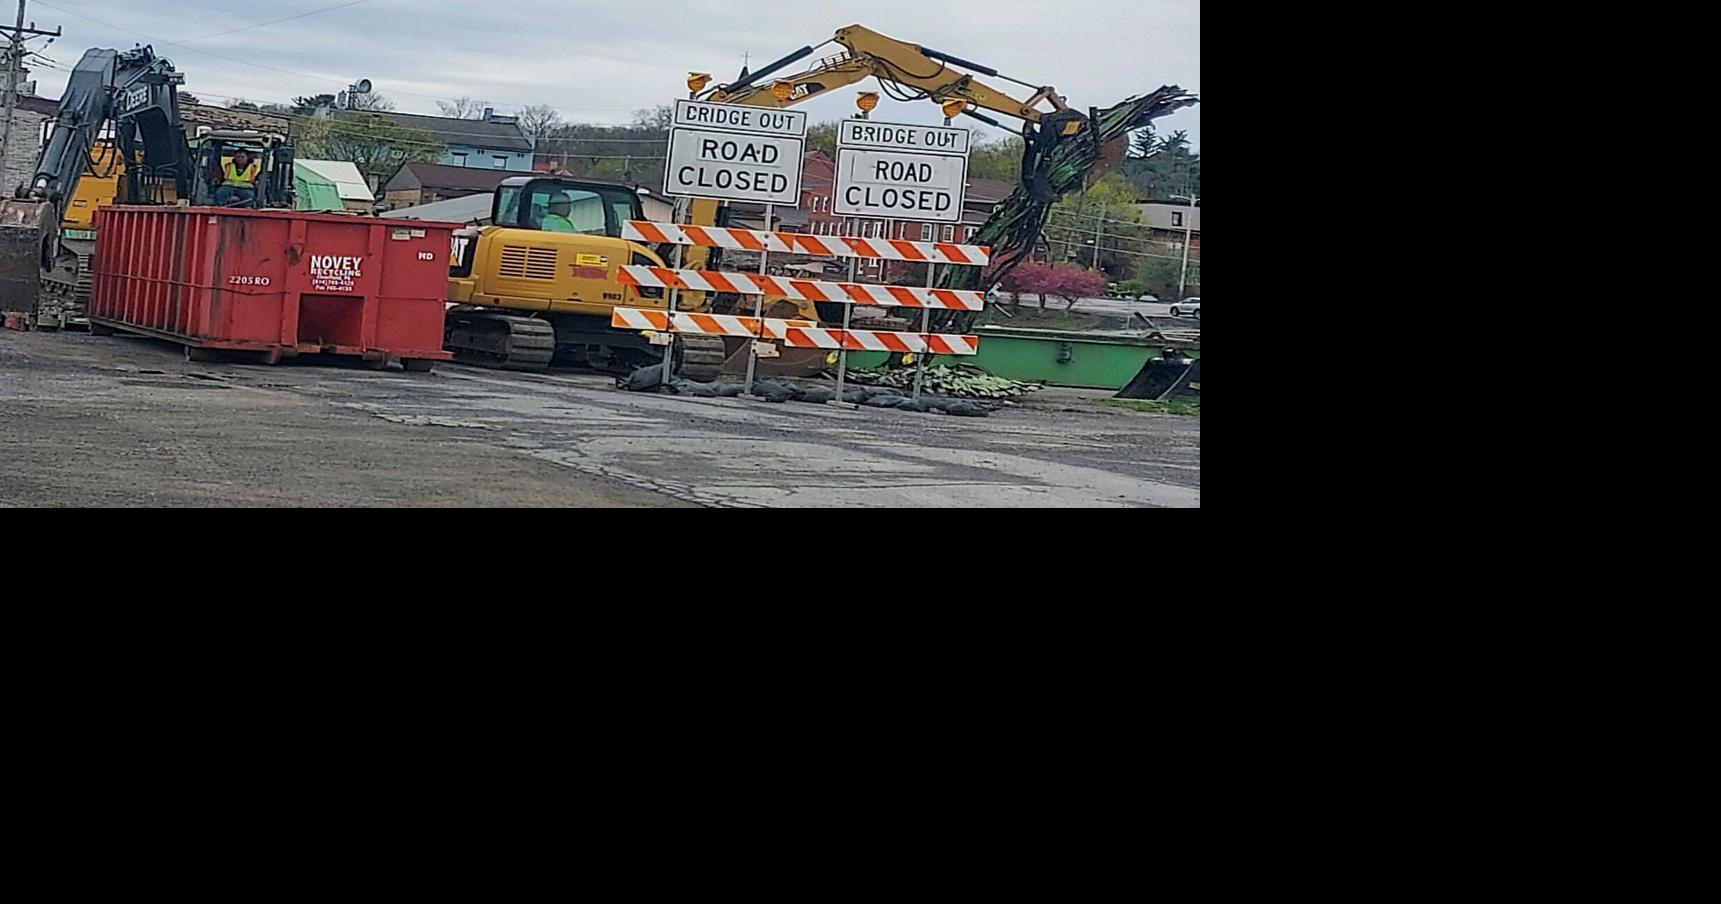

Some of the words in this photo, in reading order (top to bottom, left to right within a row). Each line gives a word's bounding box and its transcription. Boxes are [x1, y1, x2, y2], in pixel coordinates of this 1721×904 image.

[126, 85, 148, 111] DEERE
[686, 105, 751, 127] BRIDGE
[759, 113, 795, 130] OUT
[852, 125, 917, 145] BRIDGE
[924, 131, 958, 148] OUT
[701, 138, 779, 164] ROAD
[678, 166, 788, 193] CLOSED
[875, 160, 932, 183] ROAD
[845, 186, 951, 211] CLOSED
[311, 255, 362, 270] NOVEY
[450, 236, 469, 267] AT
[310, 268, 362, 277] RECYCLING
